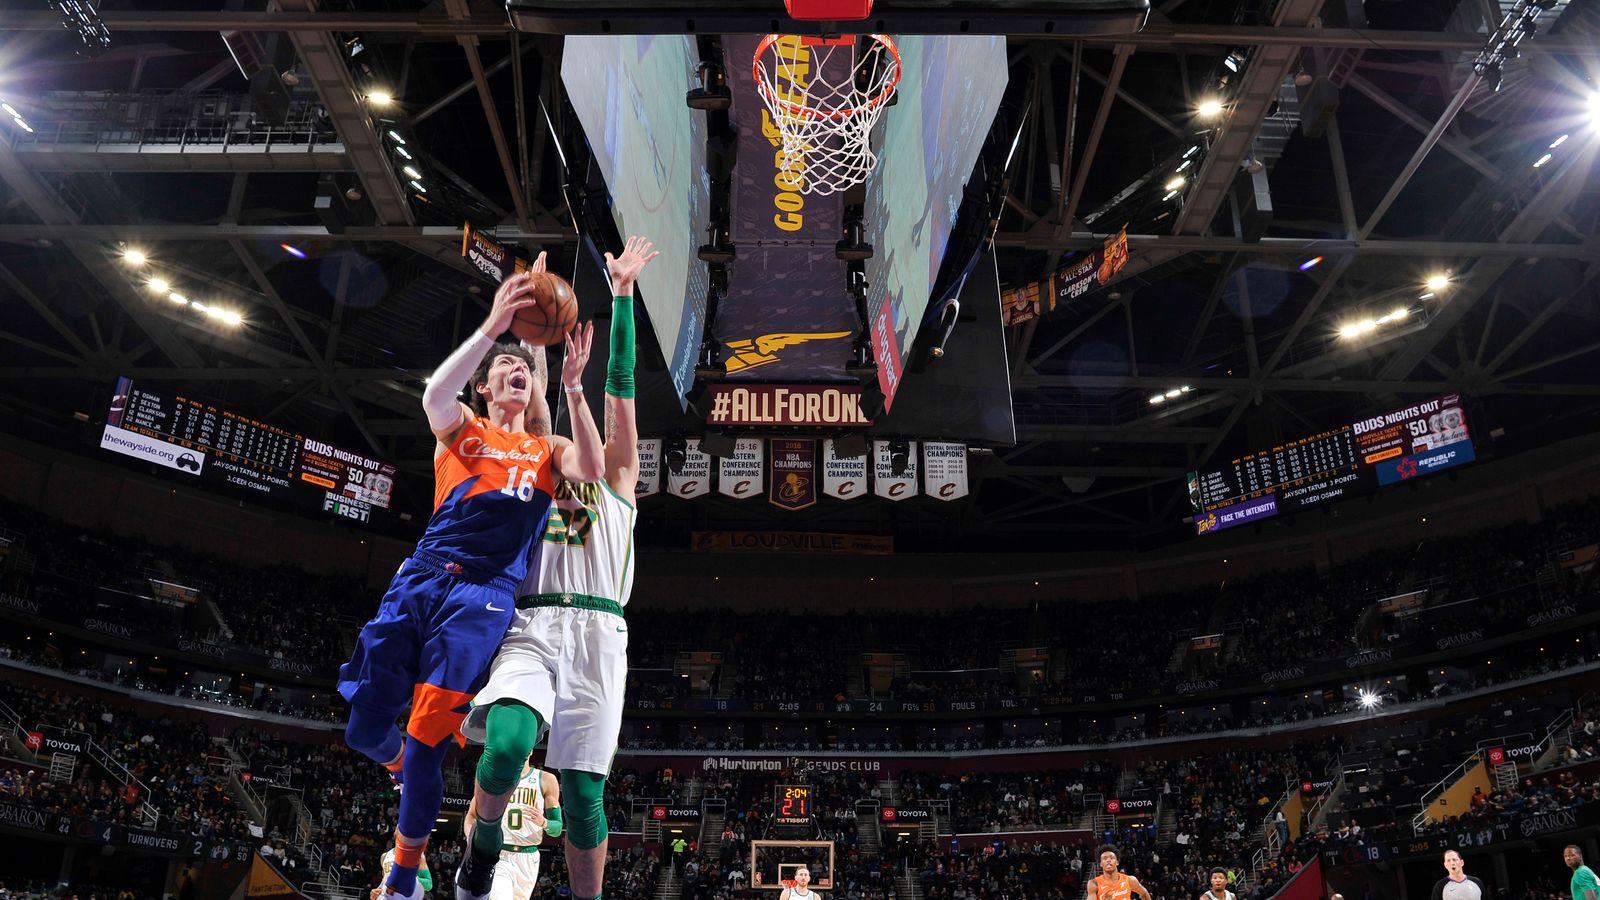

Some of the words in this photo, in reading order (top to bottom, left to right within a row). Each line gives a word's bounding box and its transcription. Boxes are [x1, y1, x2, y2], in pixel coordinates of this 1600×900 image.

[1060, 271, 1098, 297] CLARKSON'S
[1070, 284, 1089, 299] CREW
[884, 352, 897, 396] mart
[138, 406, 166, 419] CLARKSON
[1353, 416, 1385, 435] BUDS
[1385, 406, 1419, 424] NIGHTS
[1420, 400, 1440, 414] OUT
[124, 423, 138, 432] TEAM
[139, 428, 159, 438] TOTALS
[104, 433, 175, 461] thewayside.org
[304, 438, 333, 457] BUDS
[333, 449, 363, 466] NIGHTS
[363, 458, 380, 471] OUT
[458, 437, 543, 463] Cleveland
[927, 450, 964, 458] CHAMPIONS
[640, 461, 658, 469] RENCE
[722, 461, 761, 469] CONFERENCE
[774, 460, 812, 469] CHAMPIONS
[786, 453, 800, 461] NBA
[1418, 451, 1456, 467] REPUBLIC
[213, 460, 238, 472] JAYSON
[239, 467, 259, 479] TATUM
[826, 462, 865, 470] CONFERENCE
[827, 470, 863, 478] CHAMPIONS
[247, 481, 271, 493] OSMAN
[501, 465, 537, 503] 16
[1284, 488, 1307, 499] JAYSON
[1307, 482, 1327, 492] TATUM
[326, 492, 370, 510] BUSINESS
[1320, 489, 1343, 500] OSMAN
[323, 500, 369, 522] FIRST
[1220, 514, 1234, 523] FACE
[1234, 511, 1245, 519] THE
[1245, 502, 1276, 517] INTENSITY!
[1197, 513, 1217, 535] Takis
[730, 533, 844, 549] LOUDVILLE
[1539, 604, 1577, 623] BARON
[96, 619, 132, 638] BARON
[1447, 628, 1484, 646] BARON
[190, 641, 225, 659] BARON
[1357, 650, 1393, 665] BARON
[278, 658, 313, 673] BARON
[1272, 666, 1305, 681] BARON
[1186, 680, 1218, 693] BARON
[638, 700, 656, 709] FG%
[717, 700, 728, 710] 18
[779, 702, 800, 711] 2:05
[869, 702, 883, 712] 24
[902, 703, 920, 711] FG%
[951, 701, 976, 711] FOULS
[46, 738, 81, 752] TOYOTA
[1506, 744, 1542, 758] TOYOTA
[786, 757, 846, 772] LGENDS
[850, 761, 881, 771] CLUB
[253, 776, 273, 784] TOYOTA
[443, 797, 471, 806] TOYOTA
[510, 787, 537, 807] STON
[785, 788, 807, 799] 2:04
[782, 799, 805, 816] 21
[1122, 800, 1153, 808] TOYOTA
[4, 803, 48, 828] BARON
[508, 809, 523, 830] 0
[669, 809, 699, 817] TOYOTA
[1534, 807, 1577, 831] BARON
[58, 824, 70, 835] 44
[237, 852, 247, 862] 50
[102, 827, 112, 841] 4
[128, 832, 179, 850] TURNOVERS
[193, 840, 203, 855] 2
[1367, 847, 1379, 860] 18
[1408, 842, 1429, 853] 2:05
[1457, 832, 1473, 847] 24
